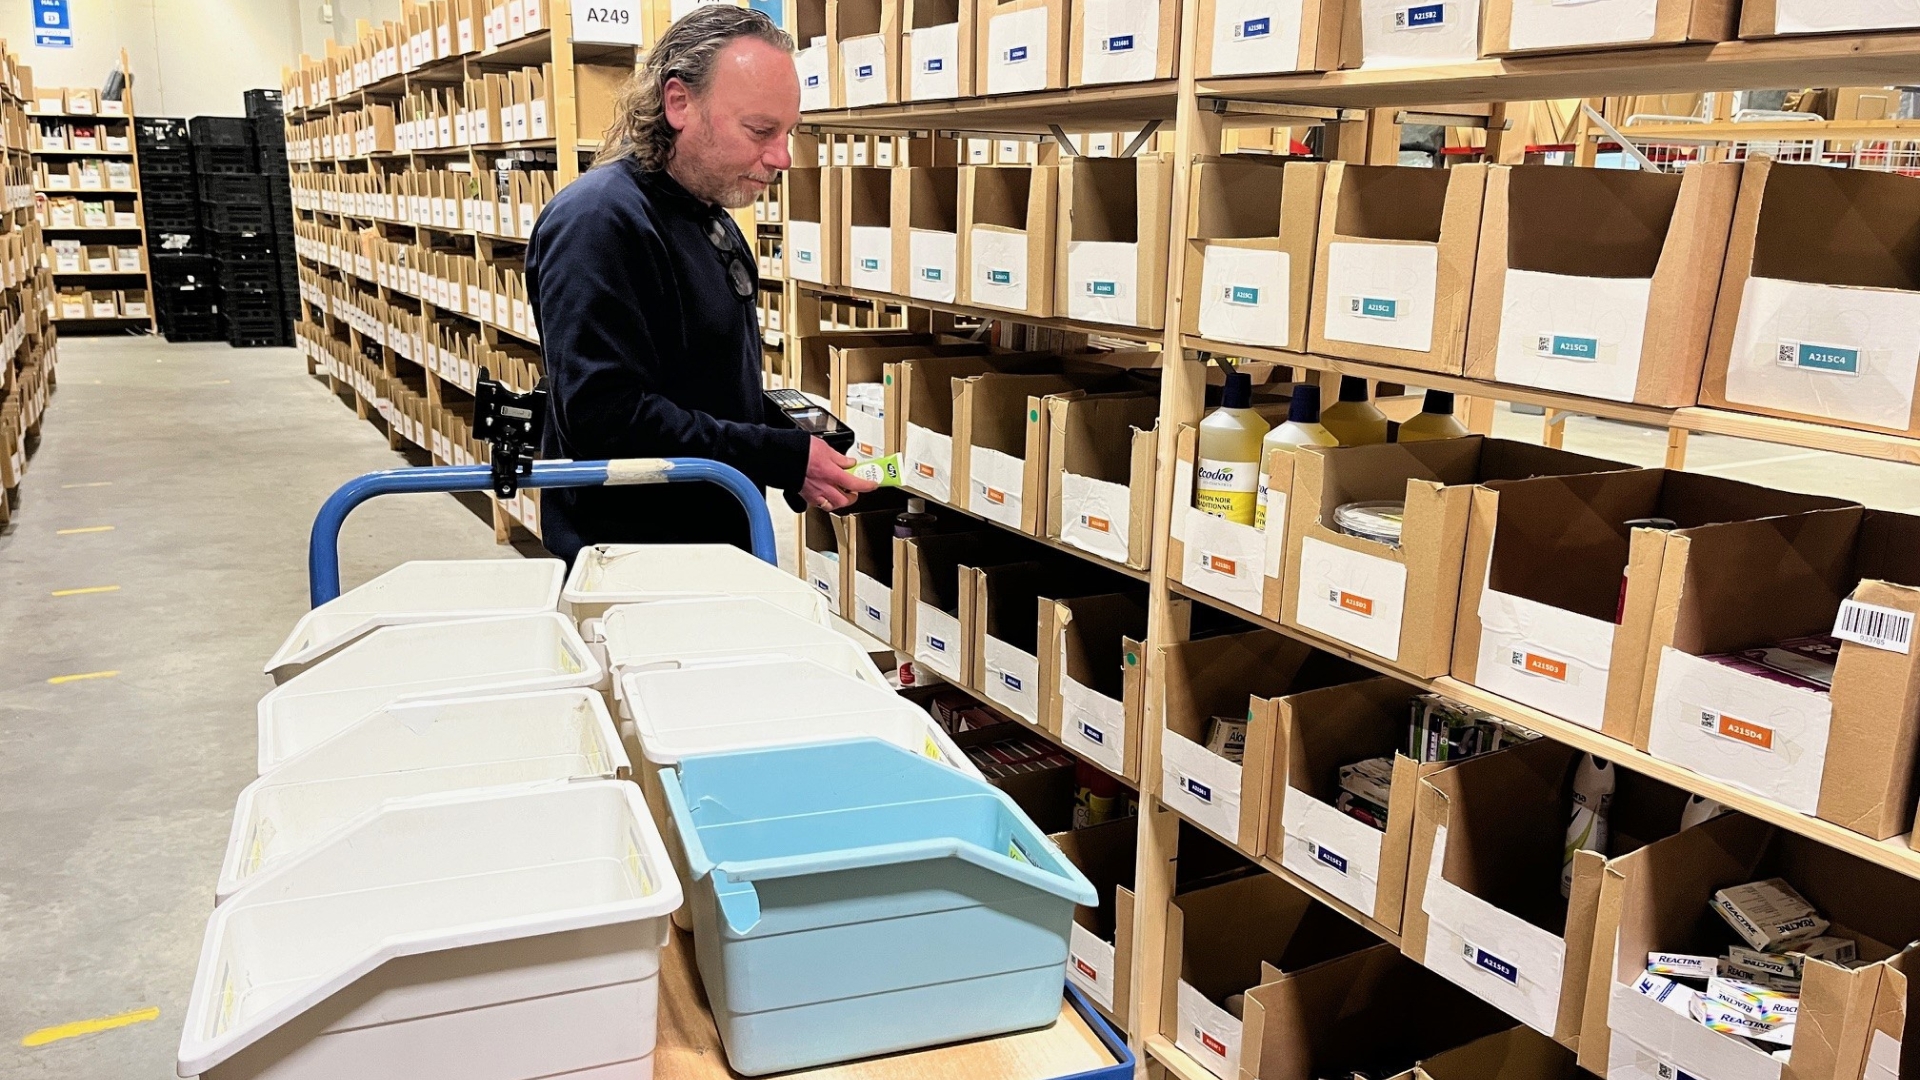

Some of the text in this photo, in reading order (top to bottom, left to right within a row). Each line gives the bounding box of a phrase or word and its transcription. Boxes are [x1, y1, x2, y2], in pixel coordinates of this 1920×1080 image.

[586, 7, 630, 24] A249
[1559, 342, 1589, 353] A215C3
[1808, 352, 1847, 366] A215C4
[1214, 496, 1231, 504] NOIR
[1532, 660, 1559, 674] A215D3
[1728, 724, 1763, 740] A215D4
[1721, 900, 1759, 935] REACTINE
[1483, 957, 1510, 975] A215E3
[1658, 955, 1703, 966] REACTINE
[1718, 993, 1754, 1014] REACTINE
[1772, 1003, 1798, 1013] REACT
[1720, 1013, 1773, 1030] REACTINE
